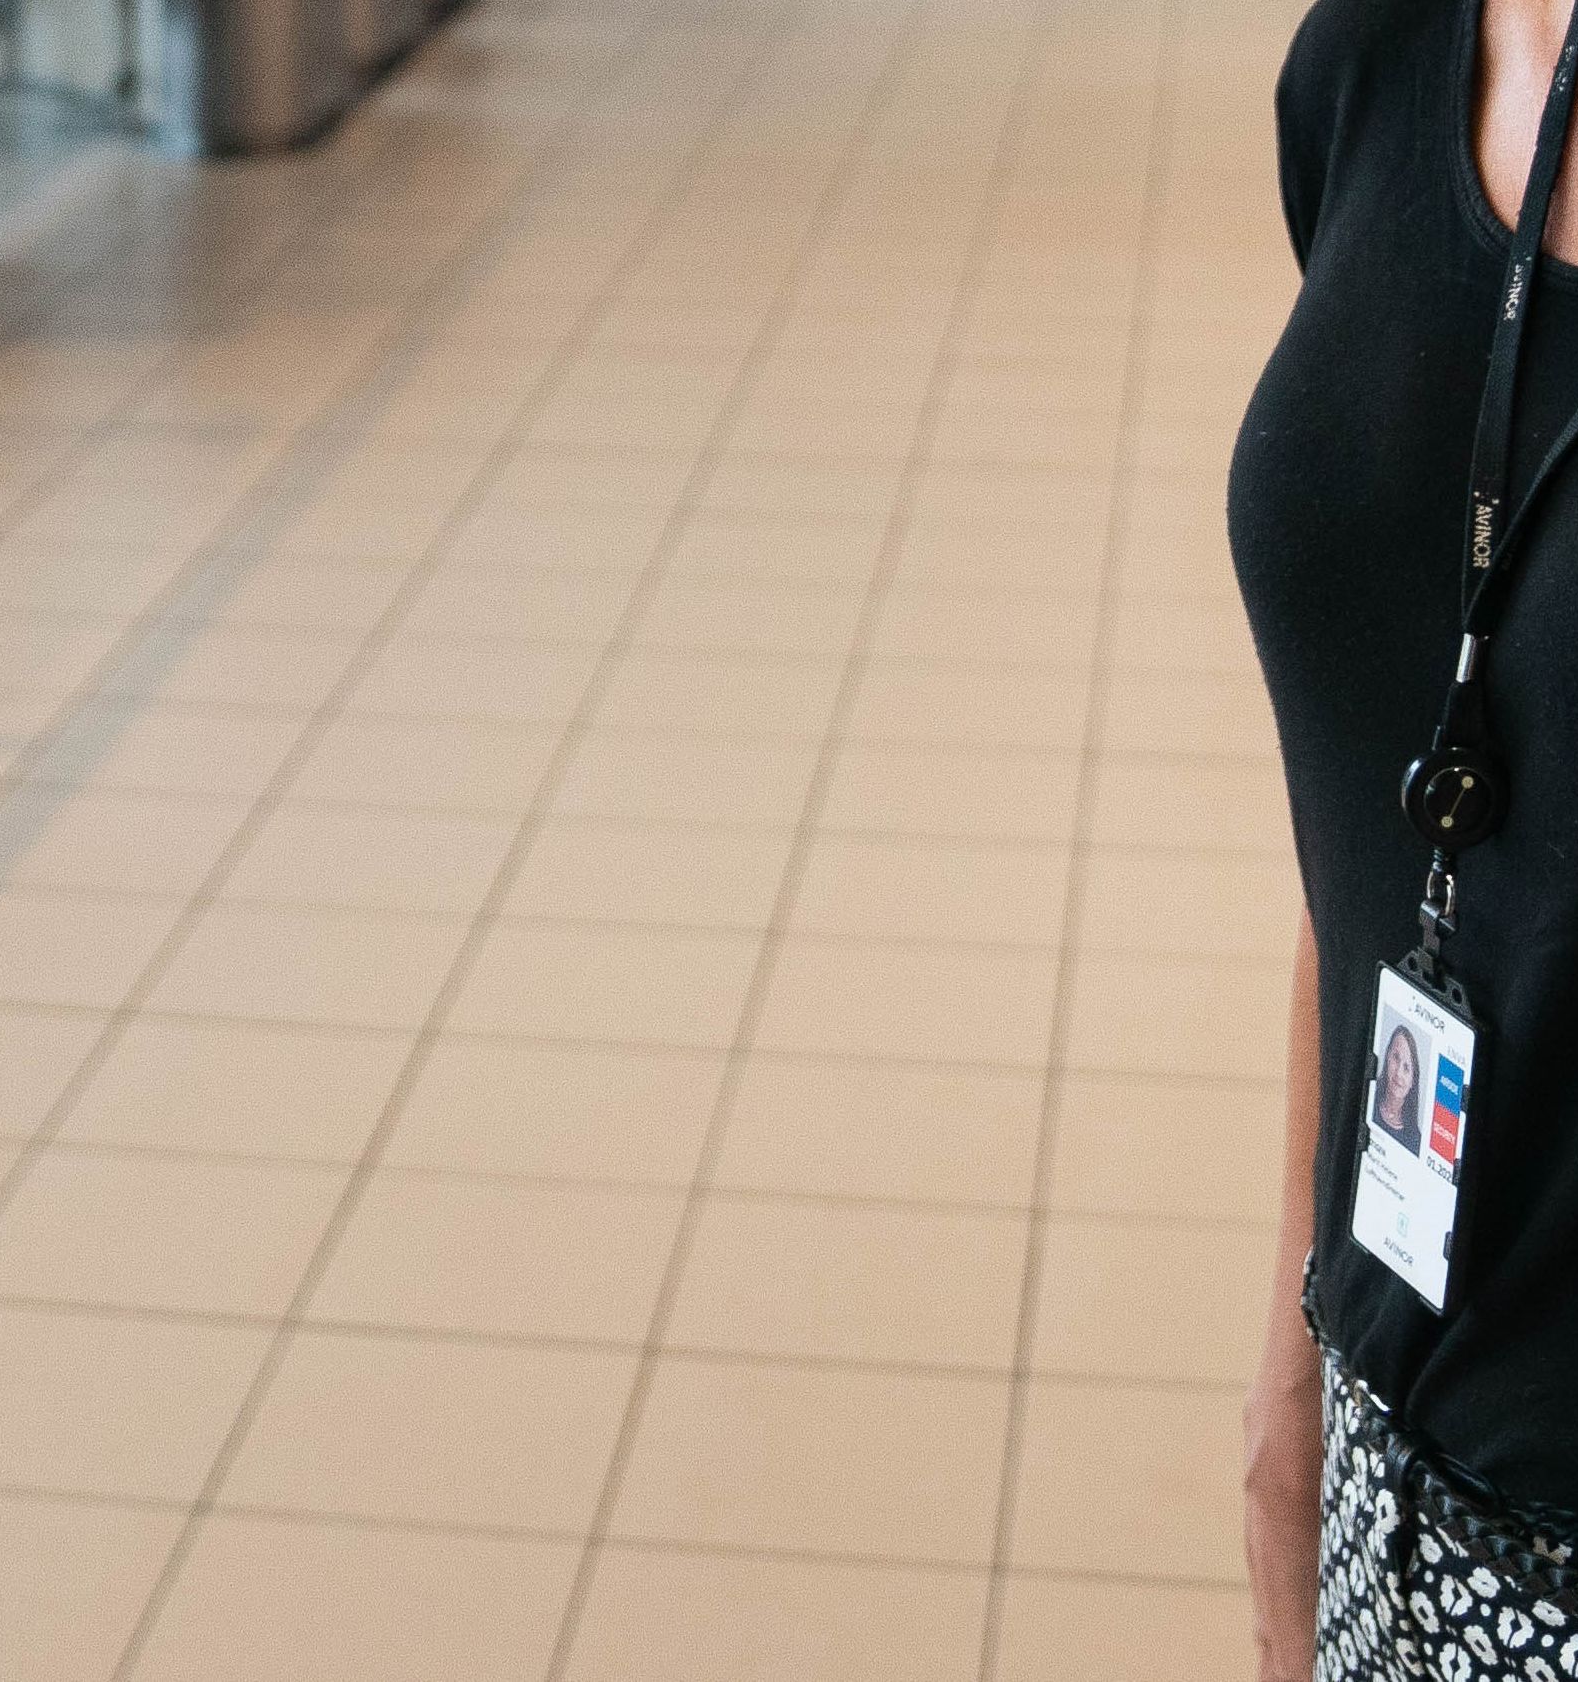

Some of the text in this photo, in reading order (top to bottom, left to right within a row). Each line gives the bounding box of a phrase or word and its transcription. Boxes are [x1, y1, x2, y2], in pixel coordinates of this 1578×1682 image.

[1473, 504, 1492, 568] AVINOR
[1414, 1003, 1445, 1034] AVINOR
[1426, 1156, 1452, 1184] 01.202
